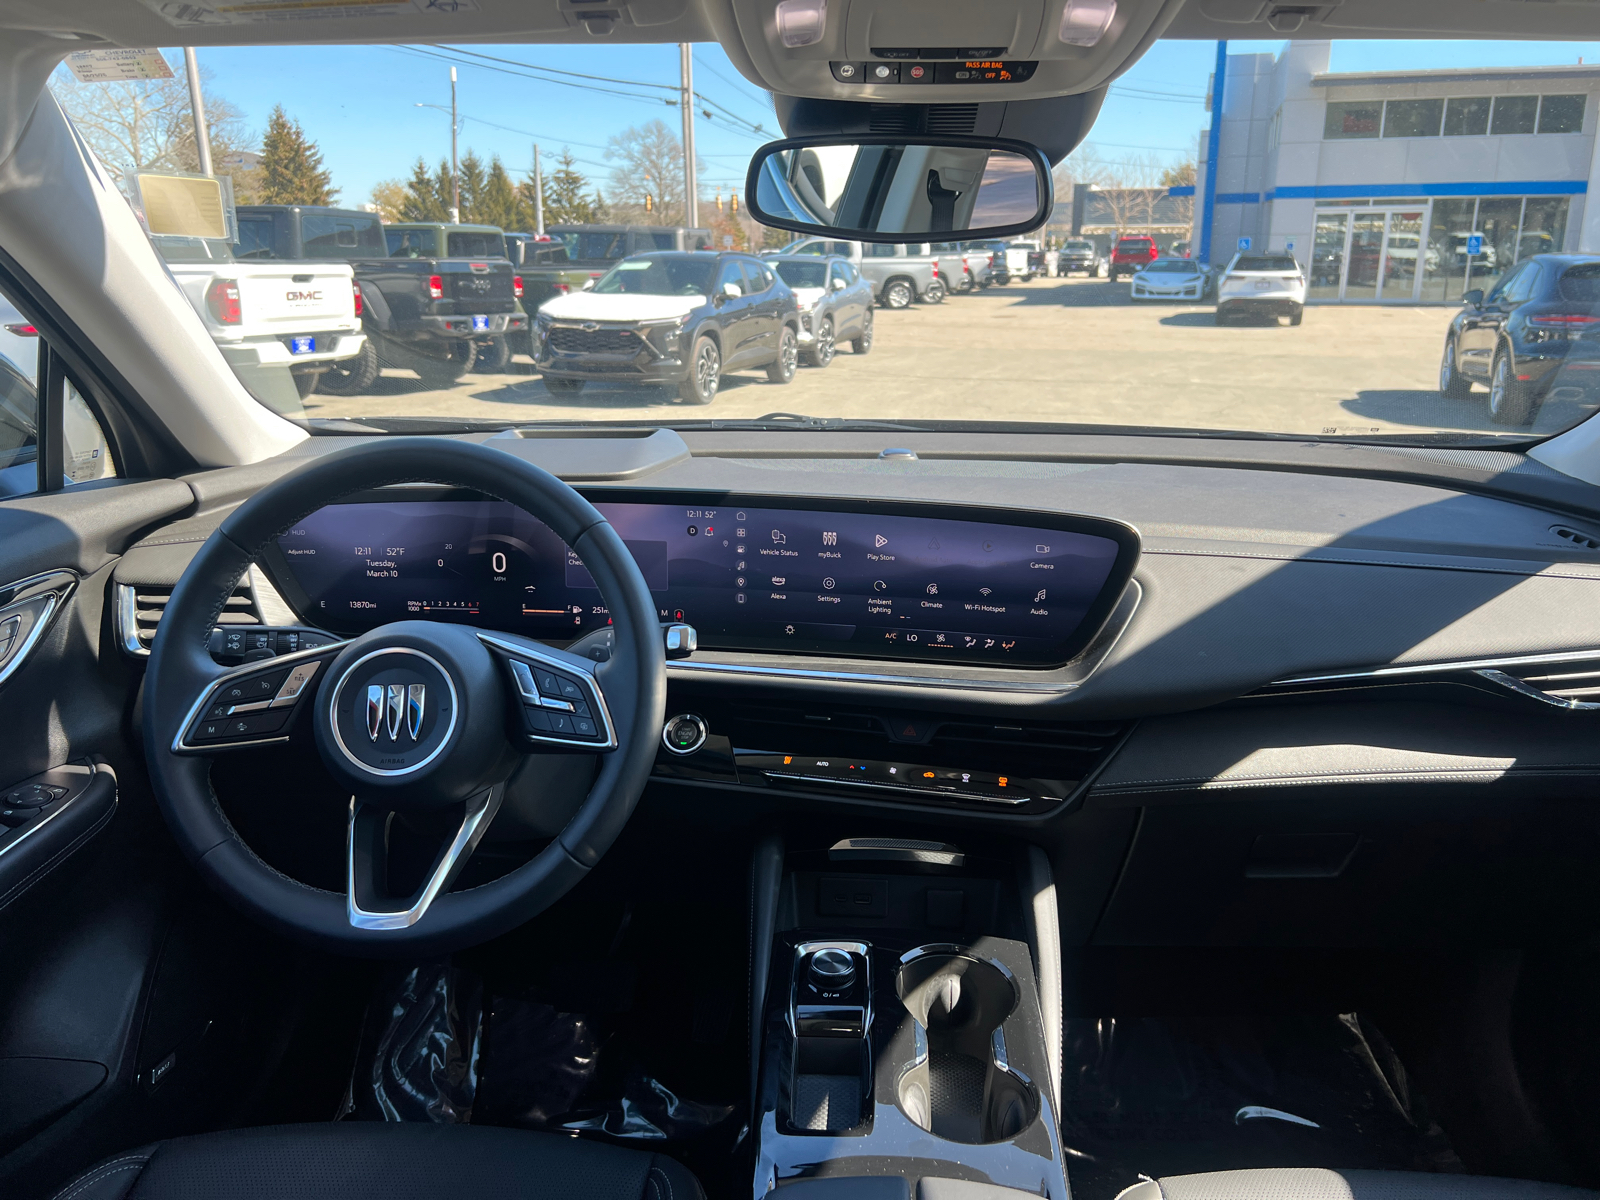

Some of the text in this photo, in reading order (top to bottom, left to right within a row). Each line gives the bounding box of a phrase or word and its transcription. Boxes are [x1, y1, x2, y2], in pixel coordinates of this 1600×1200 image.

[286, 290, 323, 300] GMC
[686, 510, 702, 518] 12:11
[354, 547, 372, 555] 12:11
[438, 558, 444, 567] 0
[492, 552, 506, 573] 0
[867, 554, 879, 562] Play
[366, 559, 397, 568] Tuesday,
[1030, 562, 1054, 570] Camera
[818, 595, 841, 604] Settings
[868, 606, 892, 614] Lighting
[982, 604, 1006, 613] Hotspot
